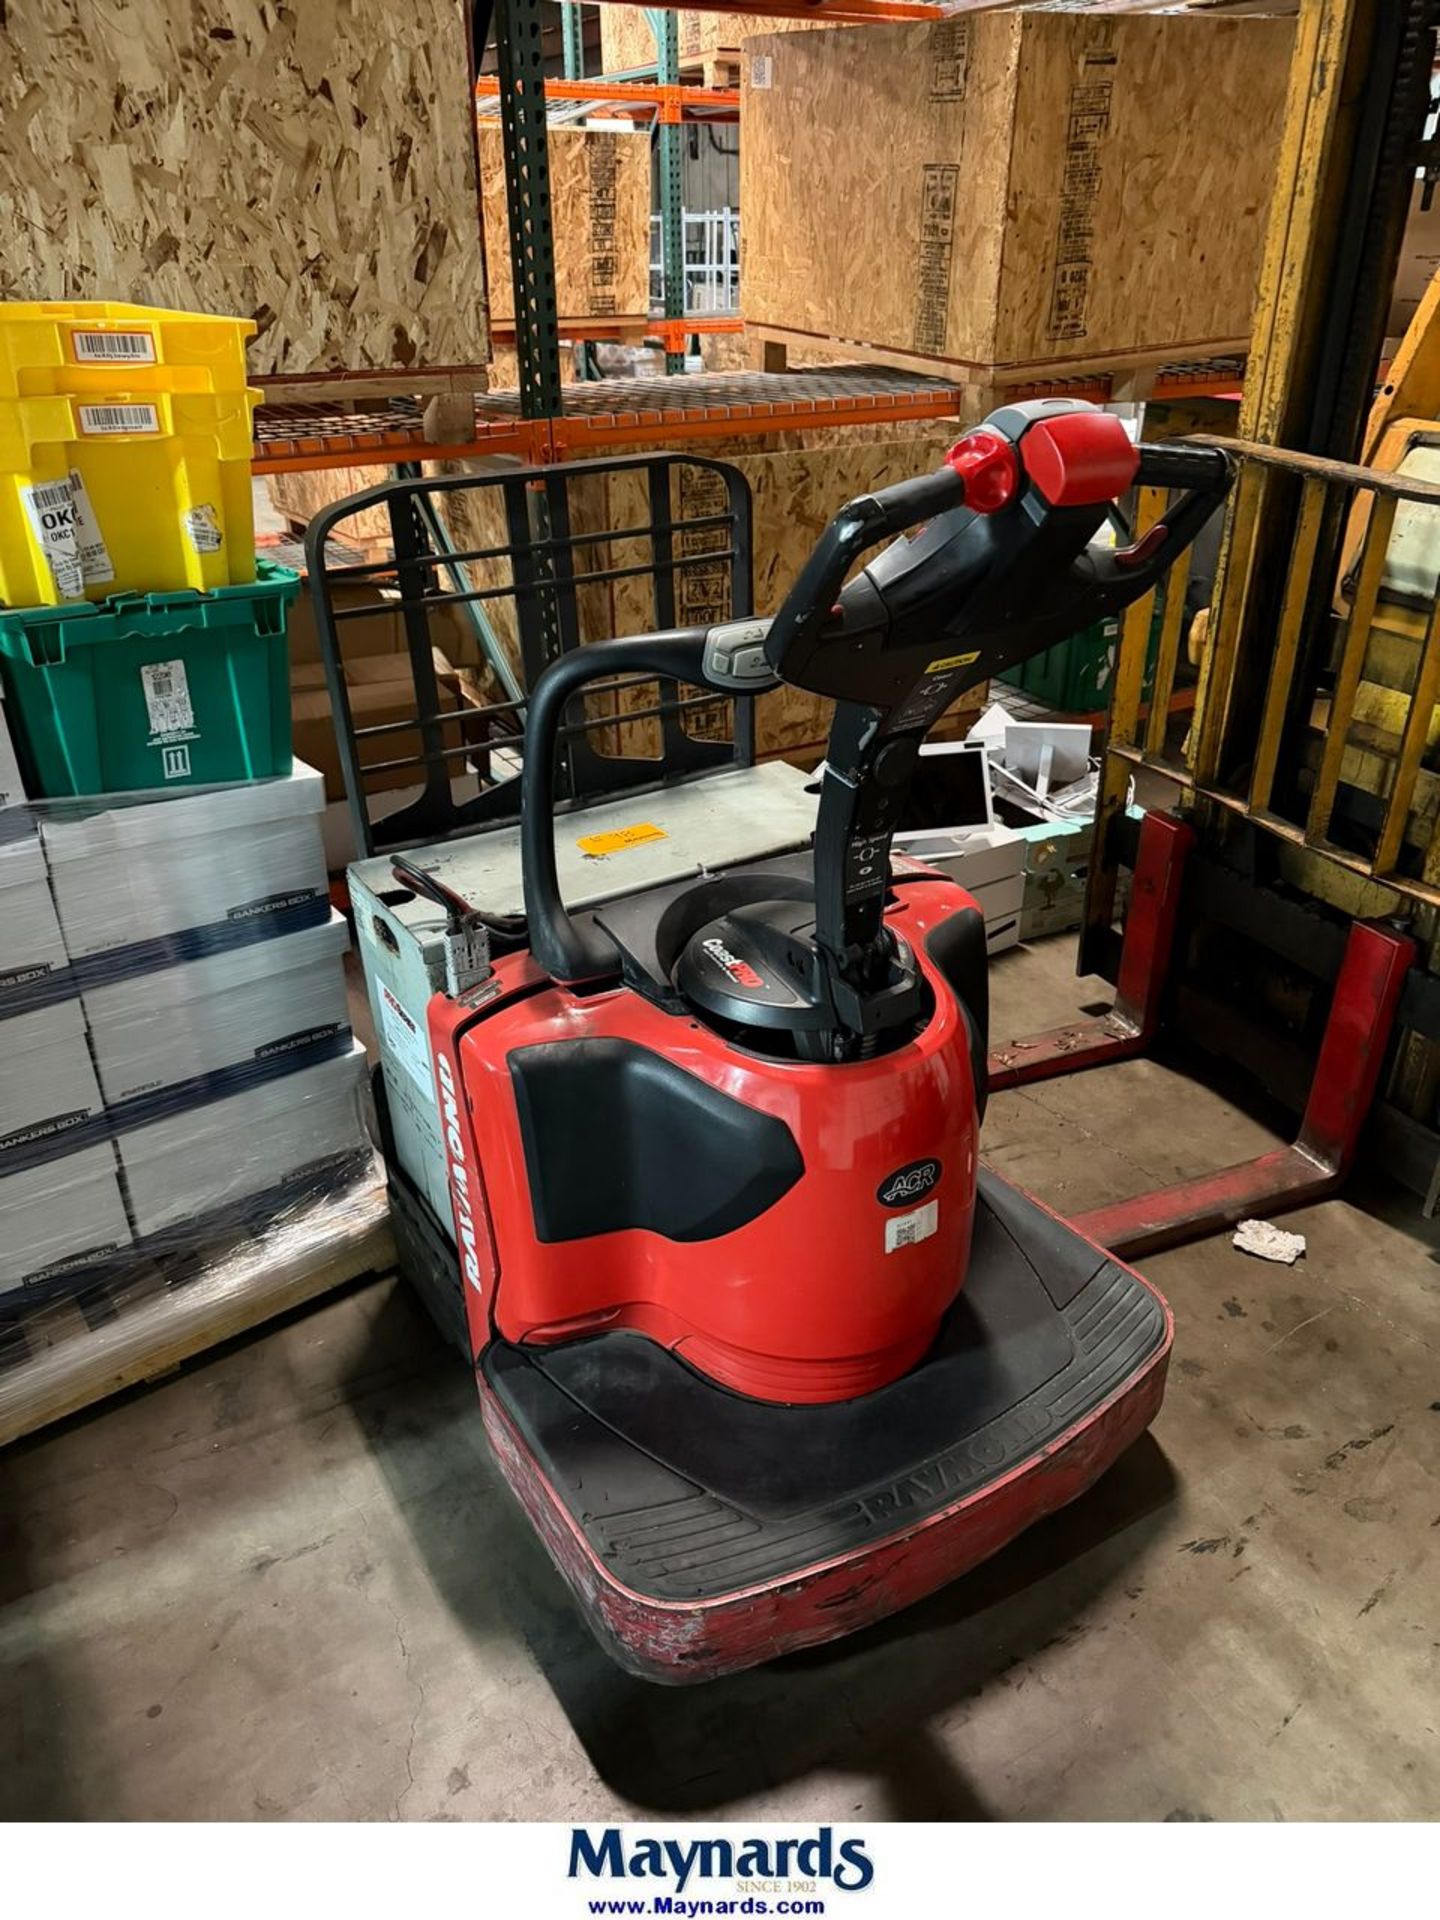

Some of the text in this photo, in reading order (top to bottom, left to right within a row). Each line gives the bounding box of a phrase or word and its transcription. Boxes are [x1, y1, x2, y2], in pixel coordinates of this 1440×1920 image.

[233, 894, 312, 919] BANKERS BOX
[16, 968, 47, 983] BOX
[57, 1114, 84, 1130] BOX
[438, 1052, 482, 1294] RAYMOND
[882, 1163, 936, 1202] ACR
[860, 1406, 1054, 1526] RAYMOND
